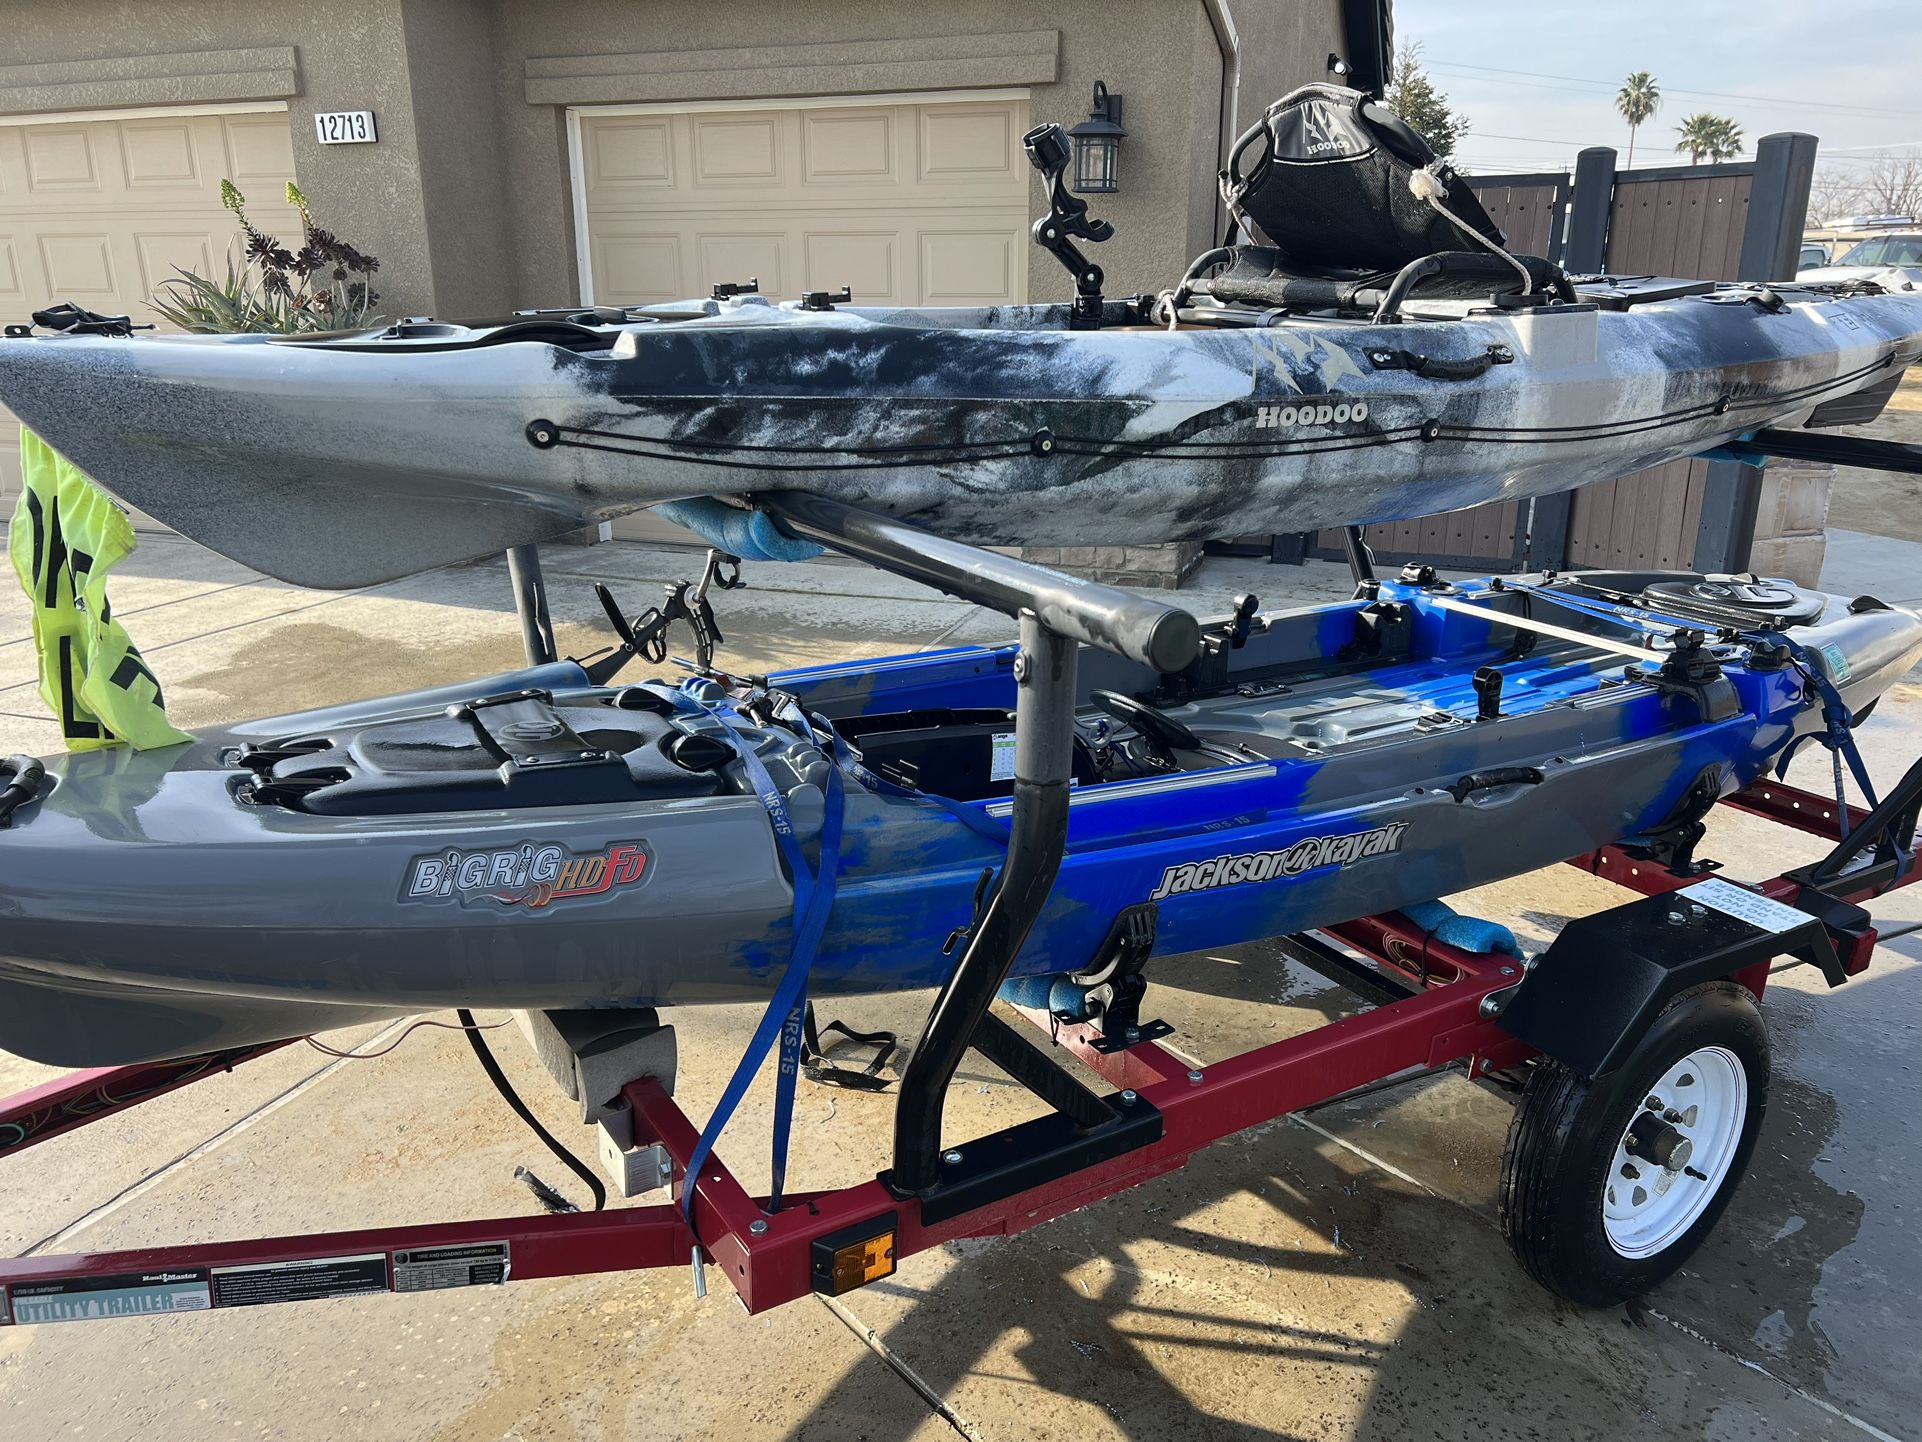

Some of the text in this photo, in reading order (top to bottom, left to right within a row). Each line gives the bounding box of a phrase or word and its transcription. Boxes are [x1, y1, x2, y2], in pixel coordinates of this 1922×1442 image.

[319, 114, 366, 141] 12713
[1256, 403, 1368, 428] HOODOO
[763, 791, 791, 835] NRS-15
[1314, 823, 1408, 867] kayak
[1697, 895, 1763, 924] CAUTION
[1714, 894, 1744, 908] NOT
[781, 1007, 802, 1075] NRS-15
[167, 1273, 198, 1281] Master
[15, 1299, 91, 1323] UTILITY
[99, 1293, 175, 1316] TRAILER
